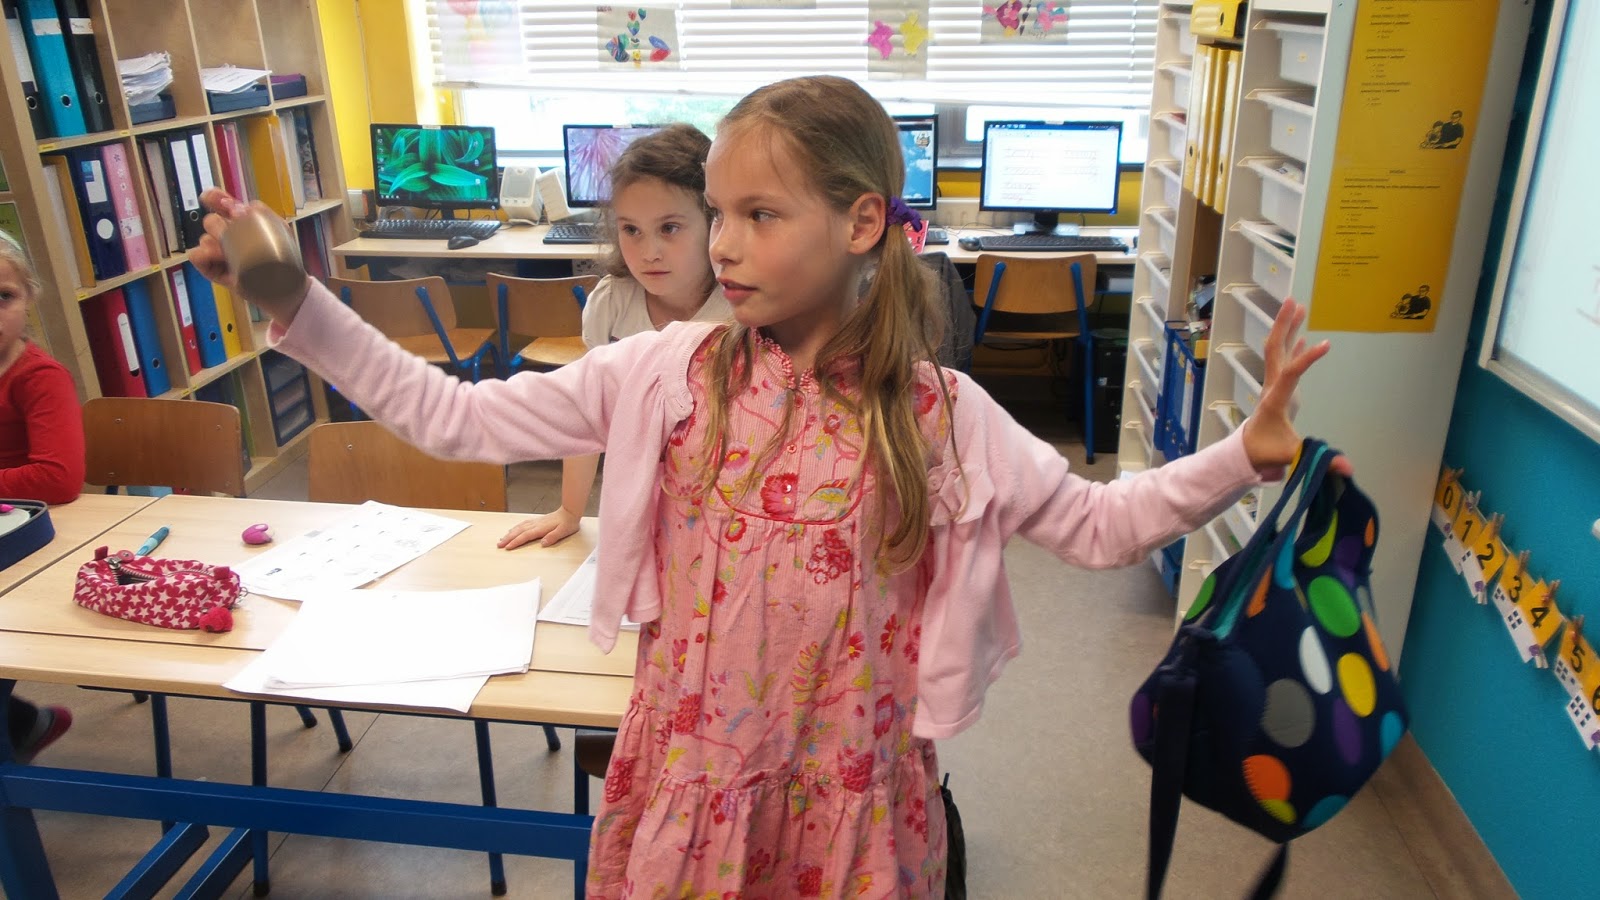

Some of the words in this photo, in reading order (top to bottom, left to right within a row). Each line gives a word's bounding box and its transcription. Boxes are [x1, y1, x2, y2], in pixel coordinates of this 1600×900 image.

[1443, 486, 1453, 509] 0
[1461, 520, 1473, 542] 1
[1477, 543, 1494, 569] 2
[1509, 576, 1523, 603] 3
[1531, 607, 1548, 628] 4
[1570, 647, 1586, 673] 5
